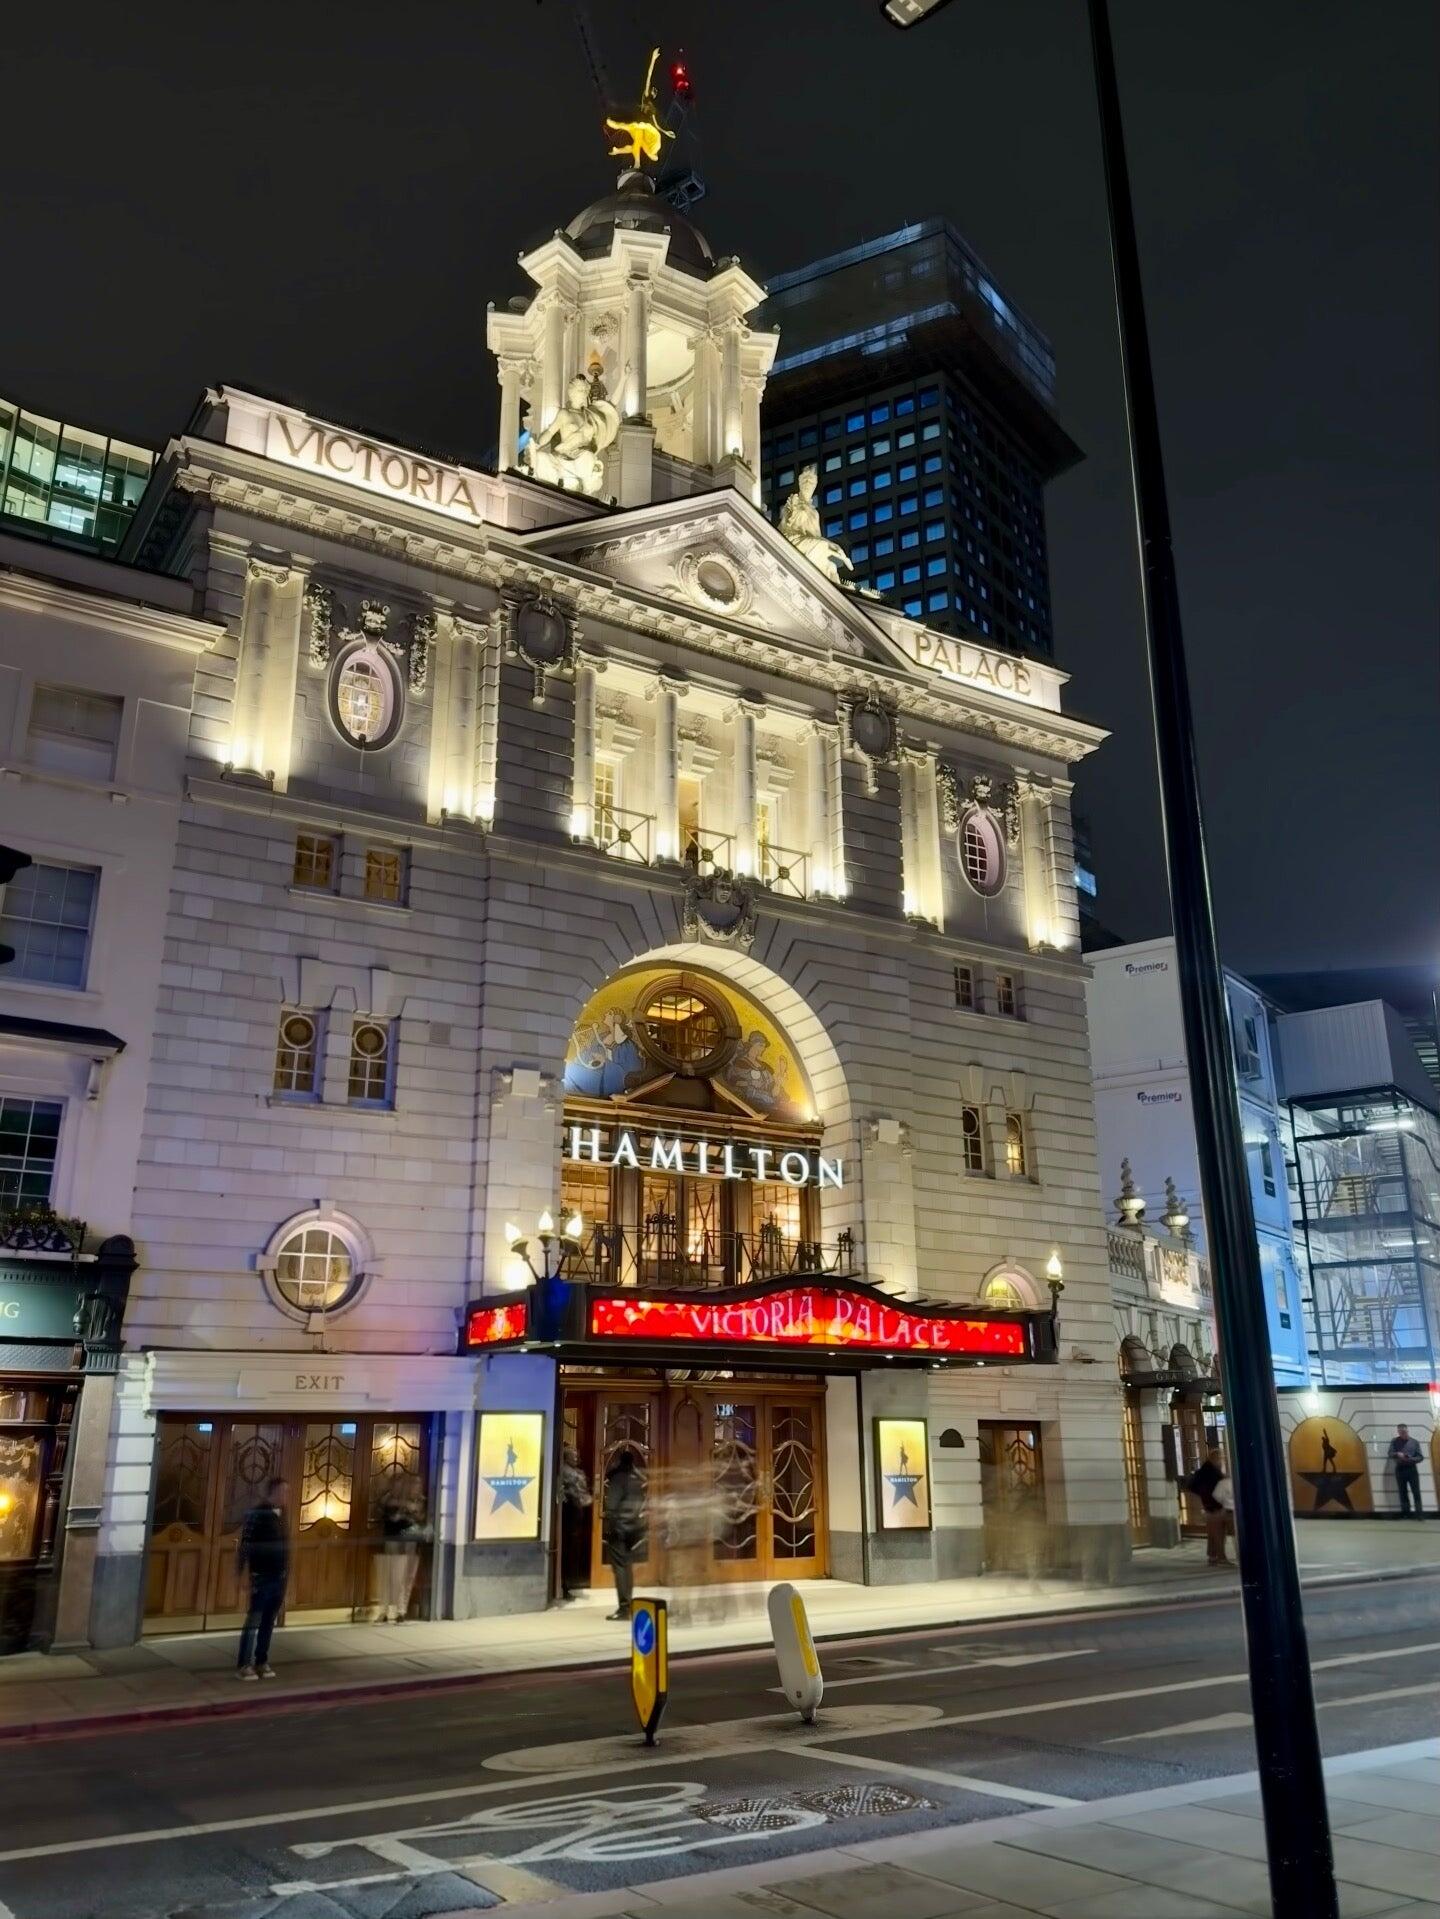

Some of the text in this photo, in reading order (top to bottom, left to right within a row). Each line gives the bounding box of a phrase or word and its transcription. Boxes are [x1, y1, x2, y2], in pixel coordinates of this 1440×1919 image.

[275, 416, 481, 519] VICTORIA
[913, 631, 1033, 697] PALACE
[1127, 961, 1166, 974] Premier
[1140, 1091, 1179, 1103] Premier
[569, 1125, 844, 1190] HAMILTON
[691, 1295, 950, 1348] VICTORIA PALACE
[295, 1374, 346, 1391] EXIT
[490, 1479, 528, 1487] HAMILTON
